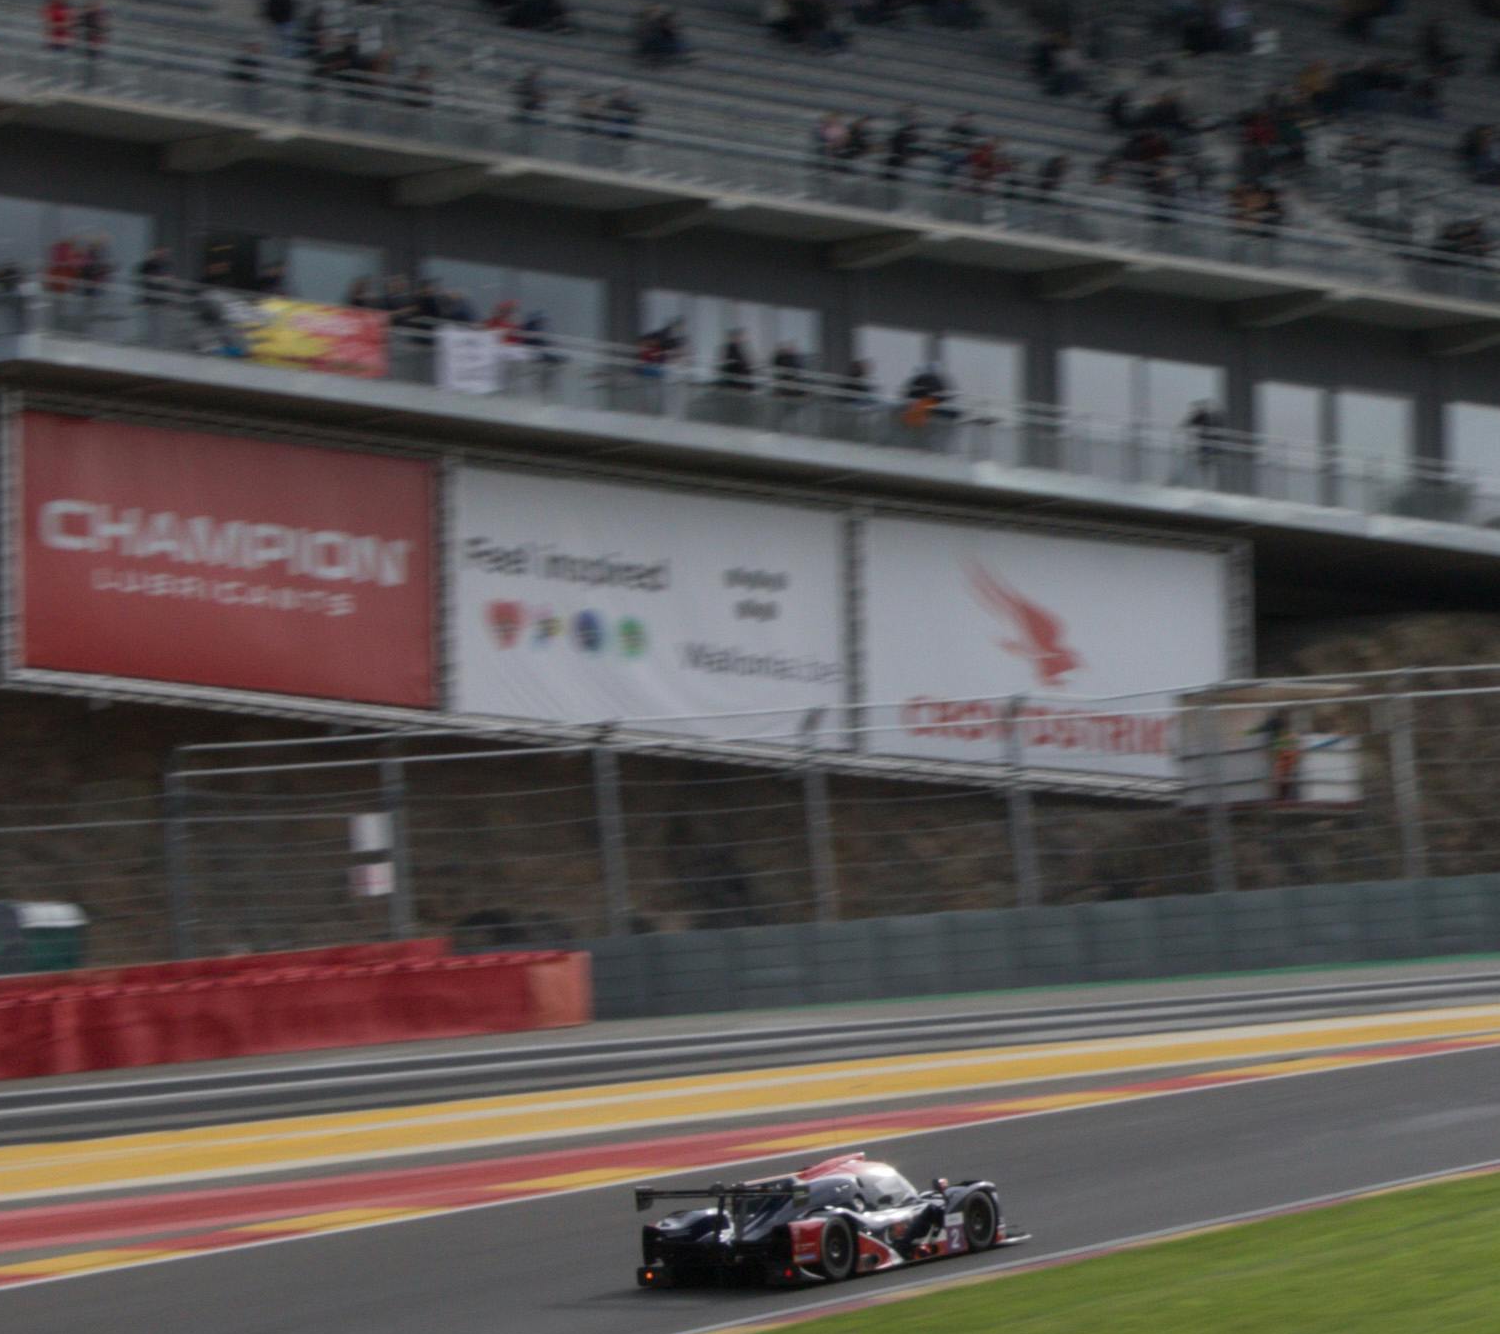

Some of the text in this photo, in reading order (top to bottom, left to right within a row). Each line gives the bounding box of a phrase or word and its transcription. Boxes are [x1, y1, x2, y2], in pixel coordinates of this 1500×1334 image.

[37, 498, 413, 587] CHAMPION
[462, 536, 533, 576] Feel
[90, 565, 356, 617] LUBRICANTS
[950, 1228, 961, 1249] 2
